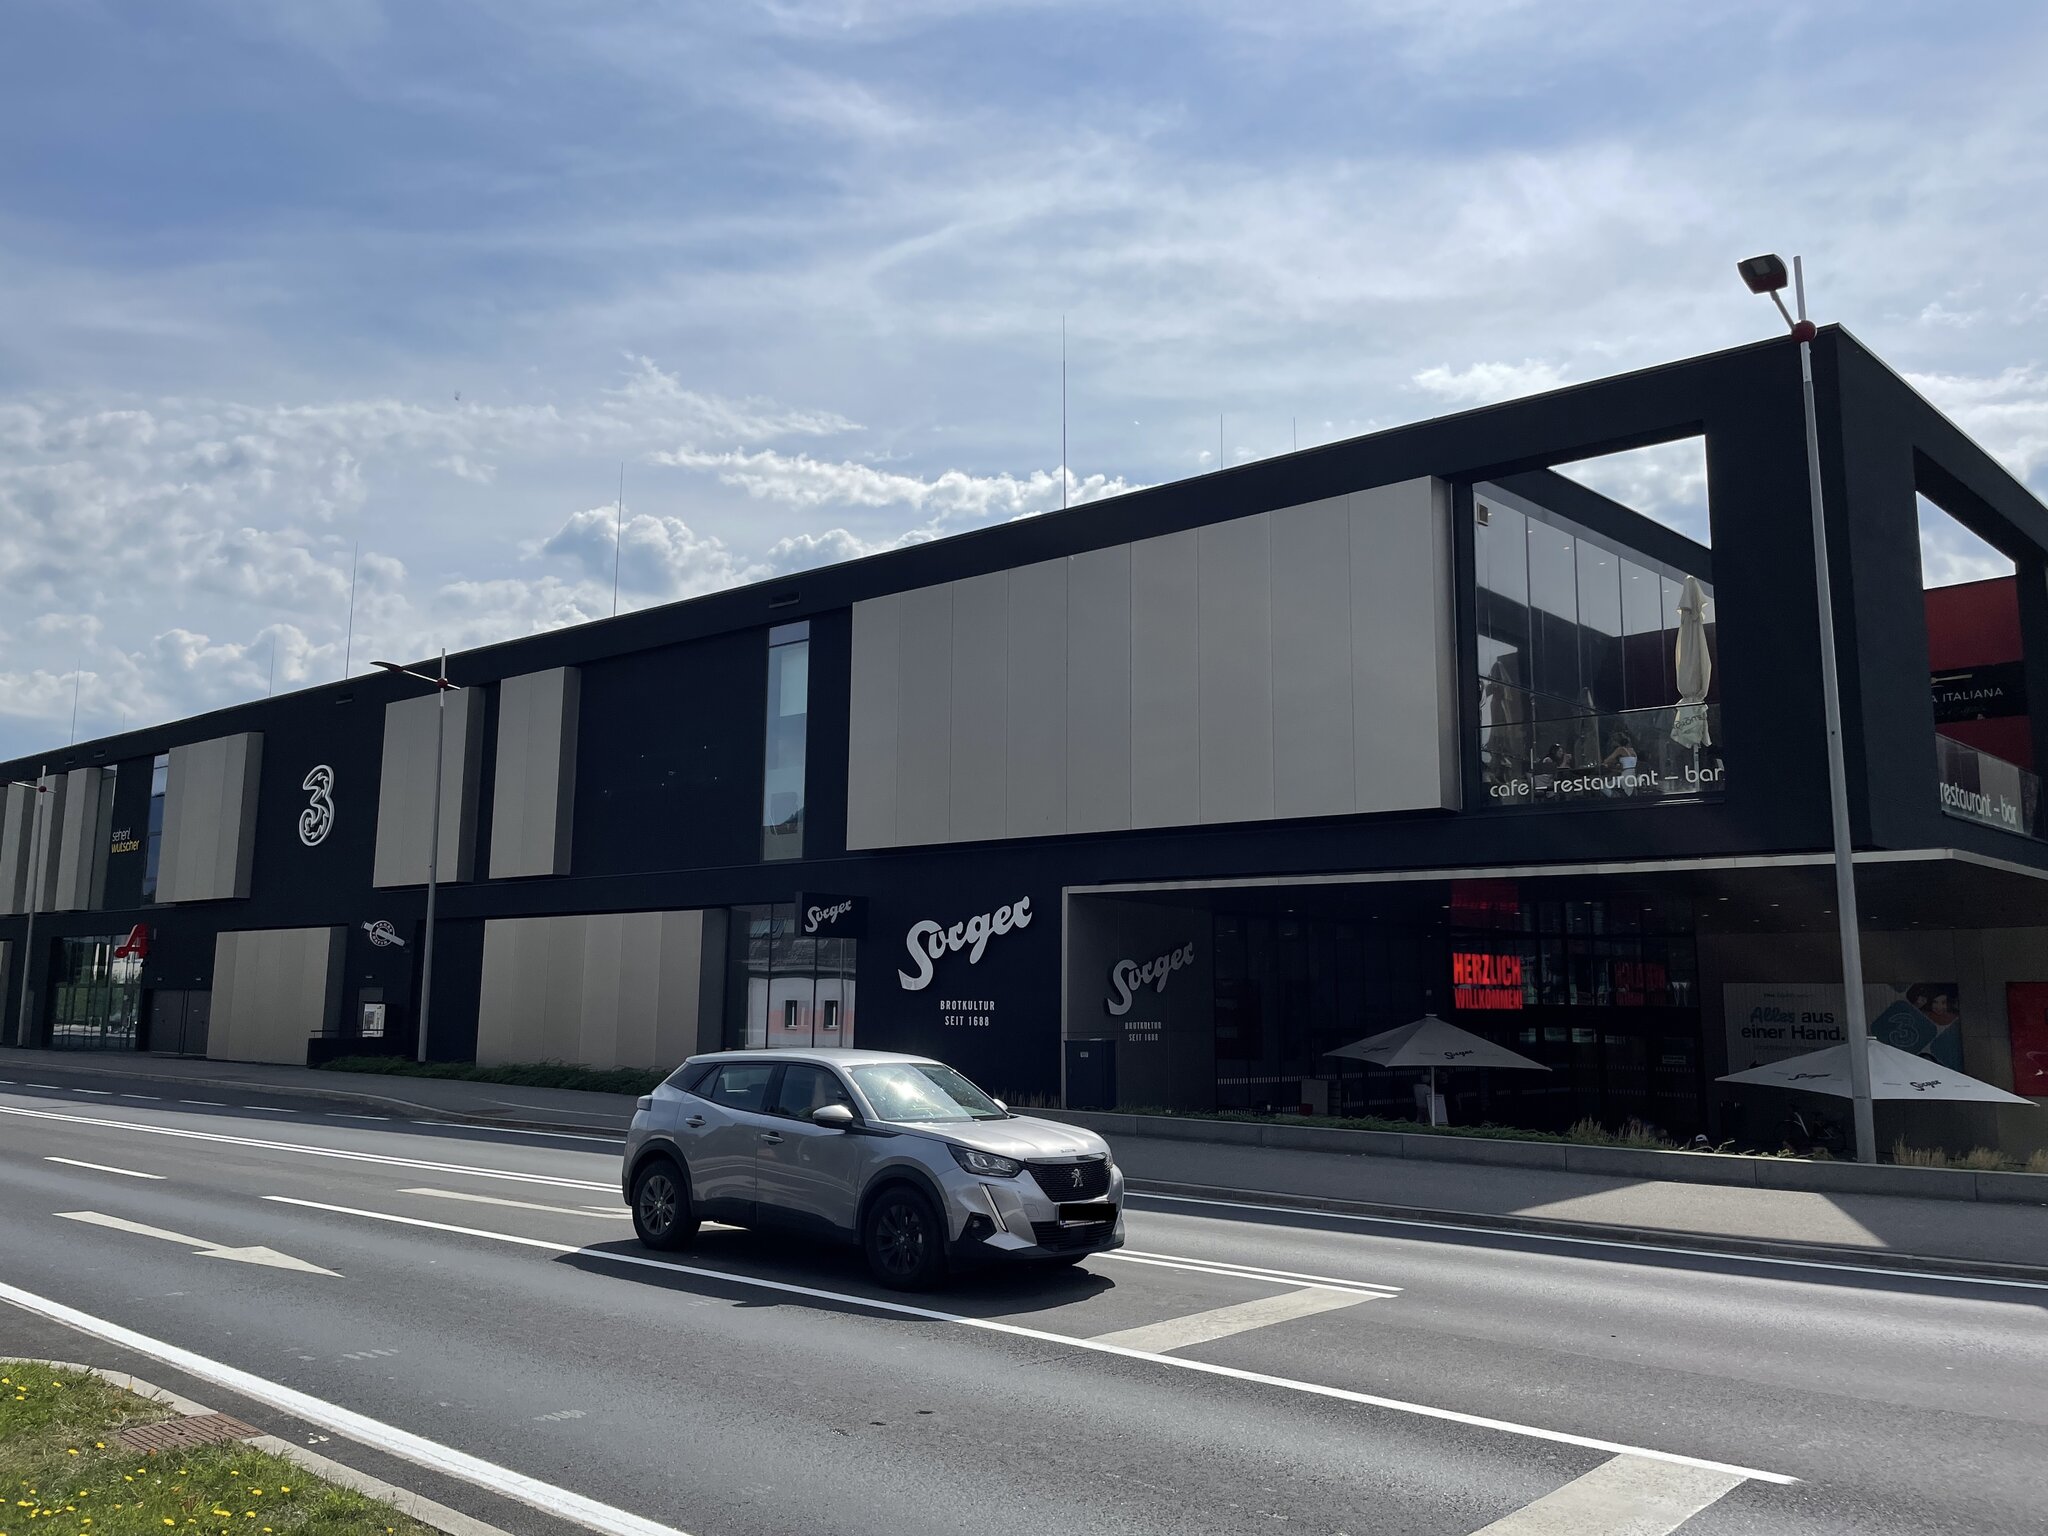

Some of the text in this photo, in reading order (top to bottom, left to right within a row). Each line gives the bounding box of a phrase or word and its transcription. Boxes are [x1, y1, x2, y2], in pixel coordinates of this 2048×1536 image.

[1942, 687, 2004, 702] ITALIANA
[1490, 778, 1529, 798] cafe
[1553, 770, 1659, 793] restaurant
[1685, 765, 1724, 784] bar
[1939, 782, 1992, 817] restaurant
[2001, 796, 2017, 824] bar
[111, 839, 140, 854] wutscher
[804, 899, 852, 933] Sorger
[897, 895, 1033, 991] Sorger
[1107, 941, 1194, 1016] Sorger
[1453, 952, 1522, 986] HERZLICH
[939, 1000, 995, 1011] BROTKULTUR
[1455, 988, 1523, 1010] WILLKOMMEN!
[944, 1015, 990, 1027] SEIT 1688
[1750, 1006, 1834, 1024] Alles aus
[1741, 1024, 1845, 1041] einer Hand.
